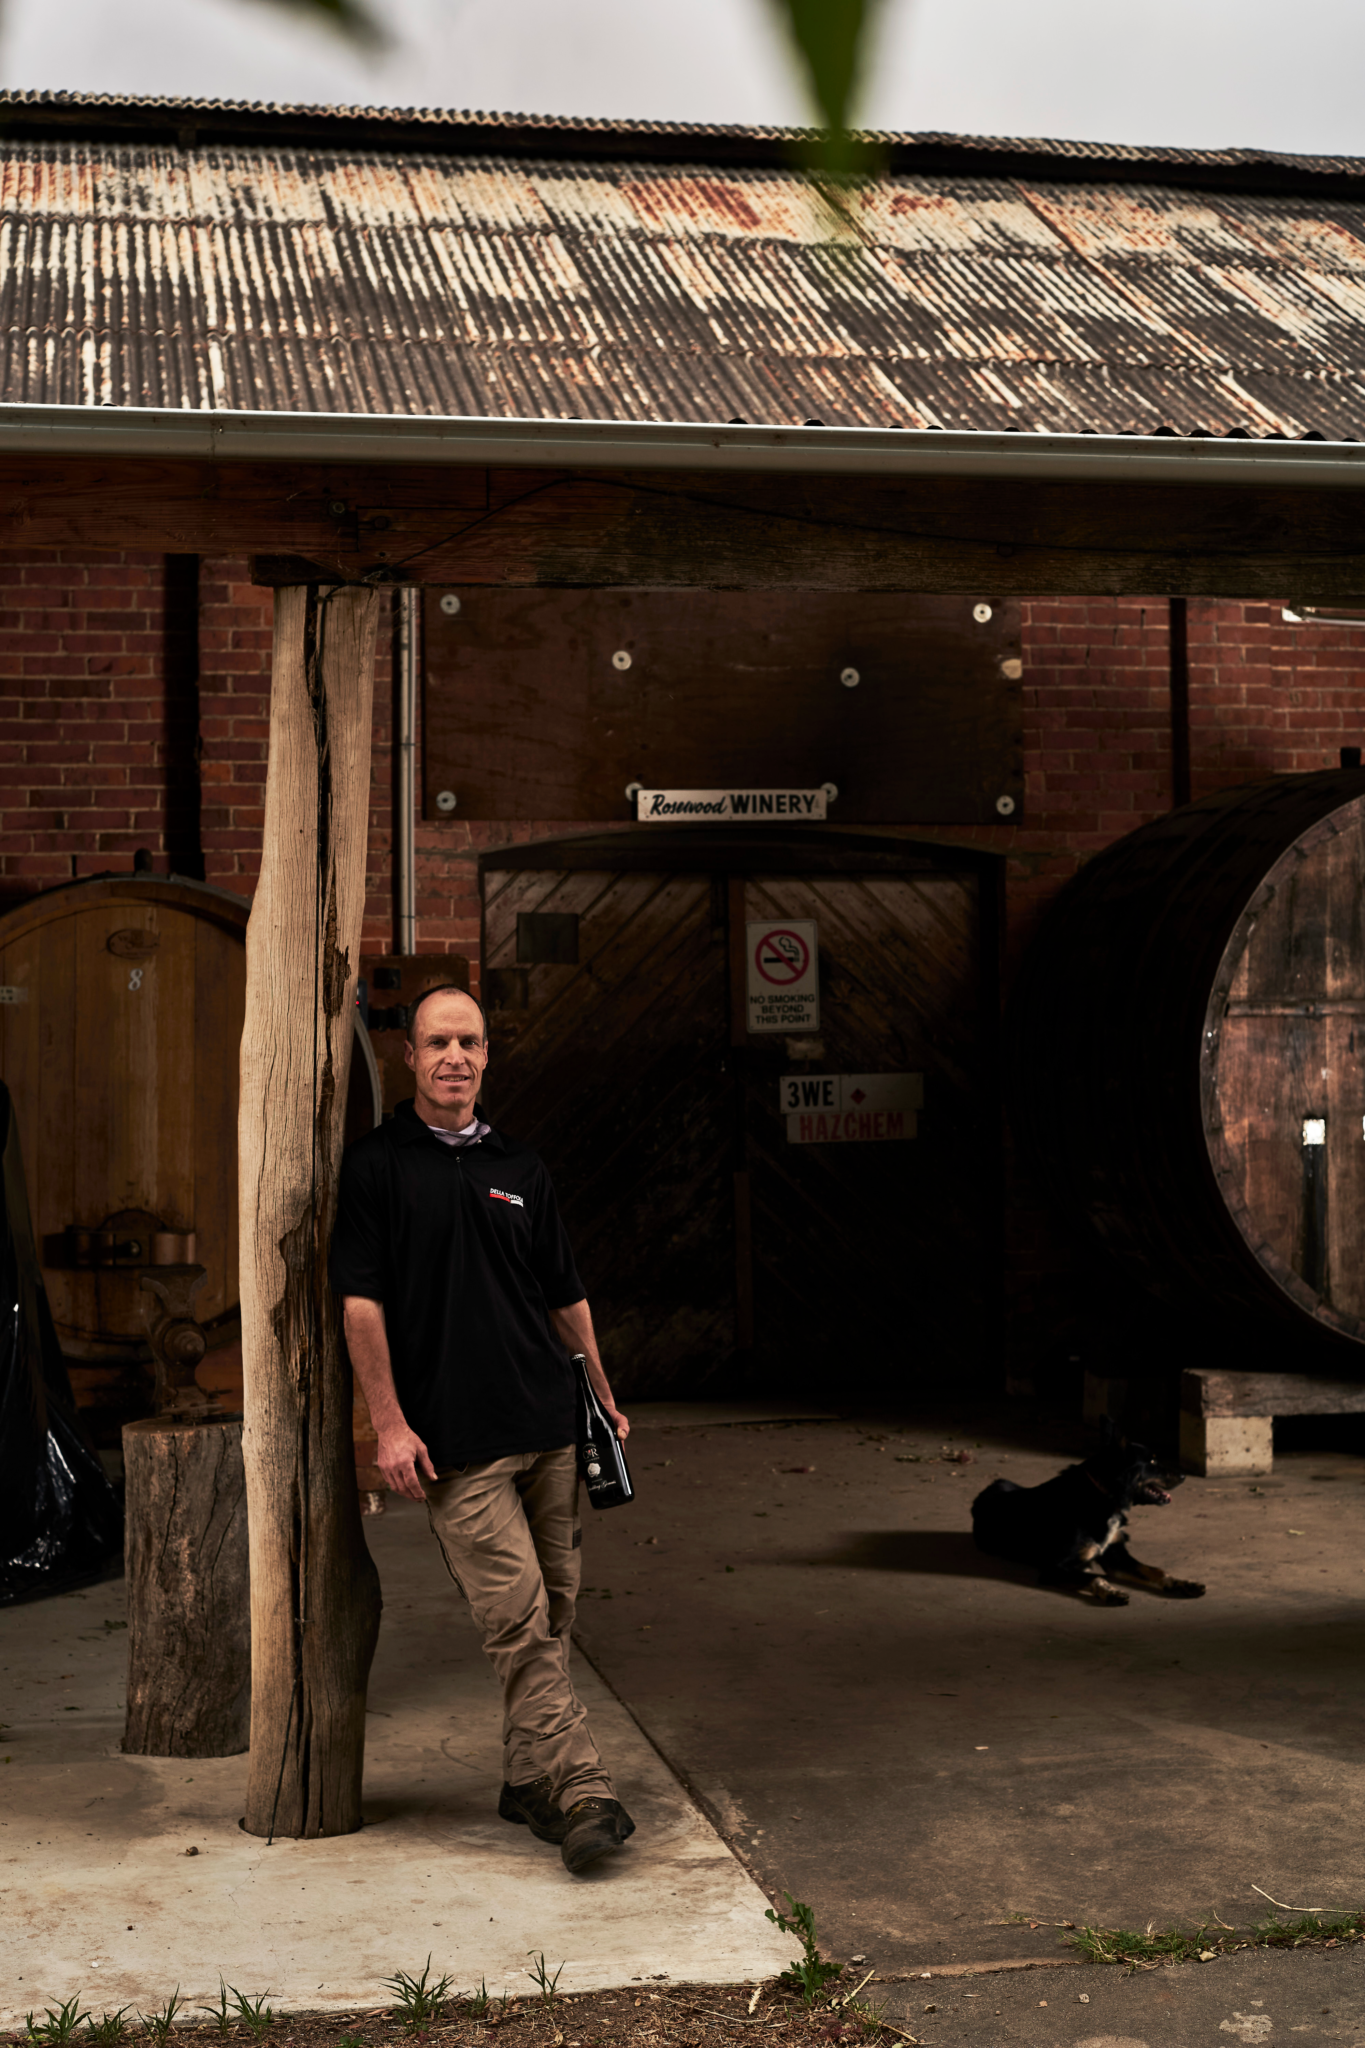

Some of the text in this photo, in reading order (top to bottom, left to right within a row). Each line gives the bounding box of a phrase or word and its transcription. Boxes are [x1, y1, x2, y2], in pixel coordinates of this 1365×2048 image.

[650, 794, 816, 815] Rosewood WINERY
[127, 968, 143, 991] 8
[750, 994, 815, 1004] NO SMOKING
[762, 1004, 804, 1014] BEYOND
[756, 1014, 811, 1024] THIS POINT
[788, 1081, 834, 1108] 3WE
[800, 1112, 904, 1141] HAZCHEM
[490, 1188, 505, 1196] DELLA
